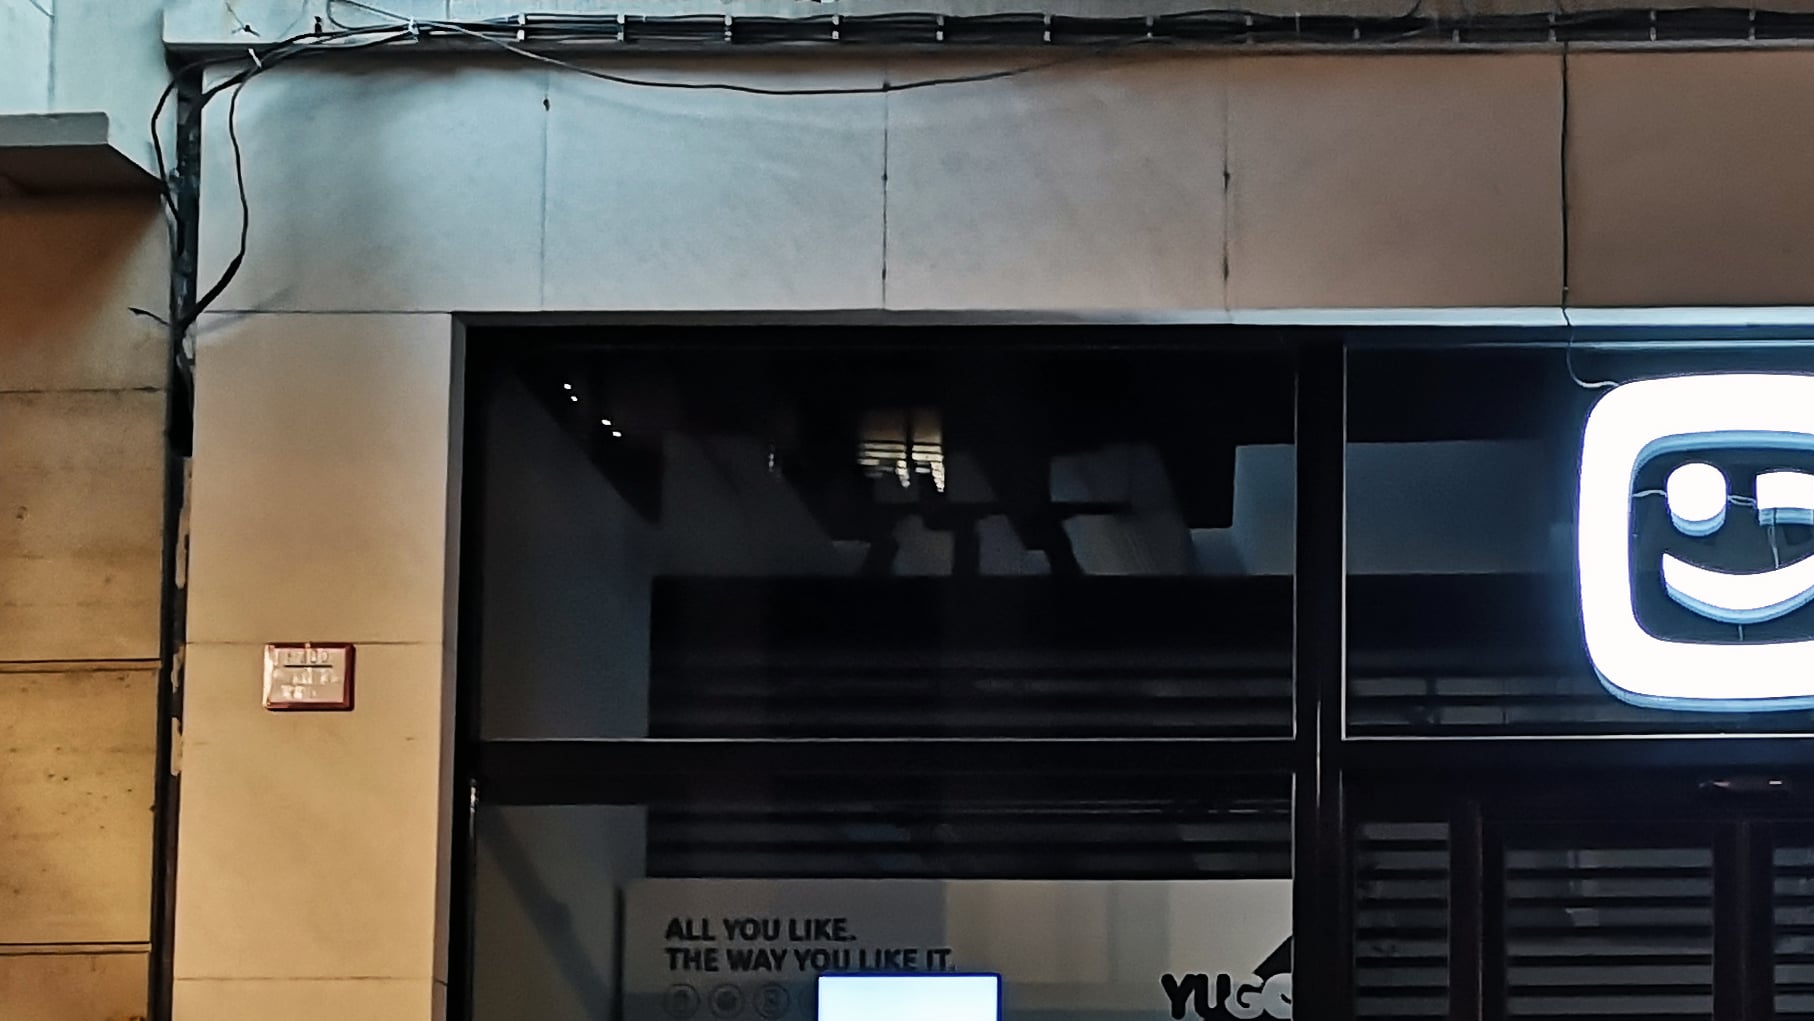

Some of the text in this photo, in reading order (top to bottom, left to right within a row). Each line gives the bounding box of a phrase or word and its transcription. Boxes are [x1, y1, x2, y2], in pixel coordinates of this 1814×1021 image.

[665, 917, 857, 942] ALL YOU LIKE.
[665, 947, 957, 972] THE WAY YOU LIKE IT.
